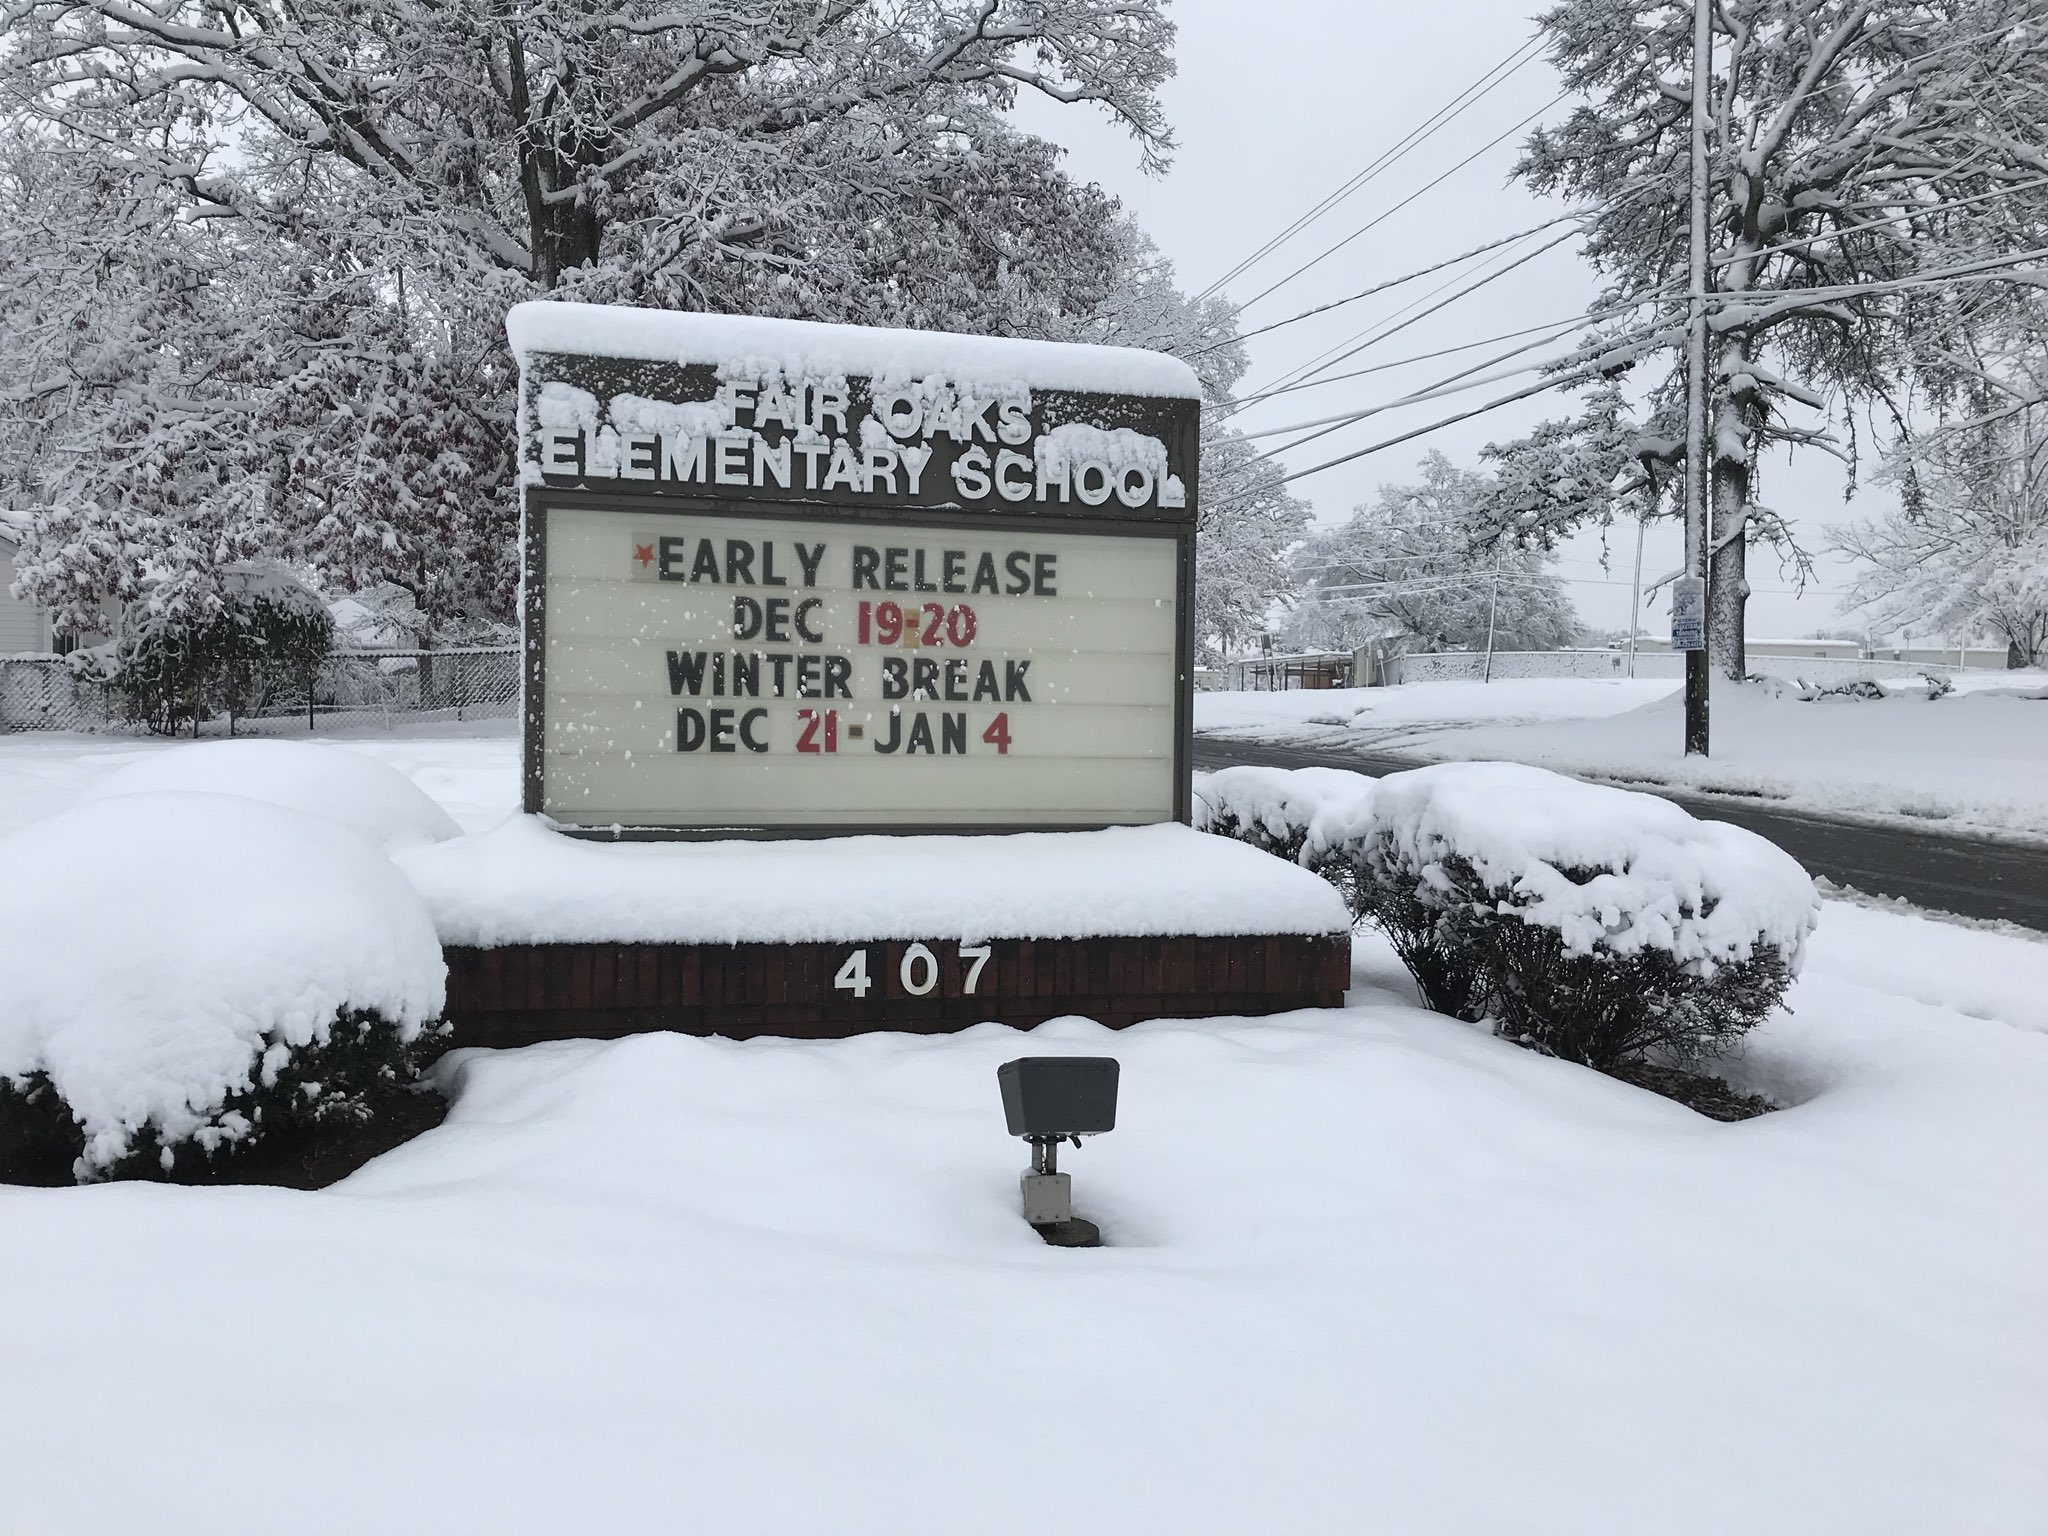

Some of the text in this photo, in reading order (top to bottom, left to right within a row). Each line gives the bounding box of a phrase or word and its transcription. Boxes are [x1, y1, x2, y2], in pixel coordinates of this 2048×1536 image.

[724, 379, 1033, 446] FAIR OAKS
[541, 426, 1186, 509] ELEMENTARY SCHOOL
[658, 535, 1058, 597] EARLY RELEASE
[733, 595, 977, 648] DEC 19-20
[665, 650, 1033, 703] WINTER BREAK
[676, 707, 769, 754] DEC
[982, 711, 1013, 755] 4
[833, 944, 993, 998] 407
